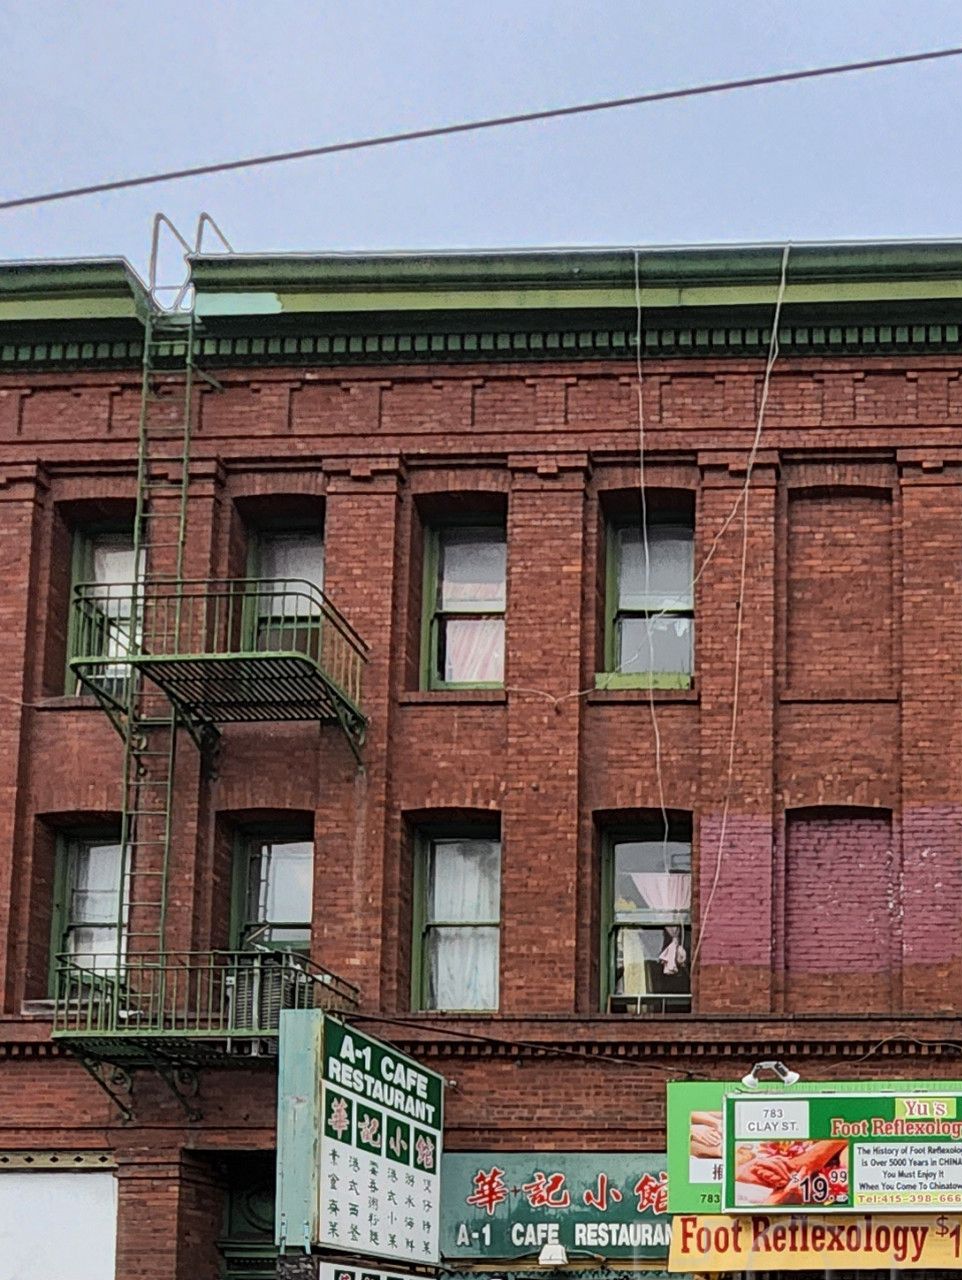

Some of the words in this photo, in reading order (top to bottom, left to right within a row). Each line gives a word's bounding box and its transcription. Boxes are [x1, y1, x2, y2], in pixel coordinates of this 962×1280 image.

[340, 1034, 372, 1071] A-1
[380, 1055, 428, 1100] CAFE
[328, 1056, 435, 1124] RESTAURANT
[763, 1109, 784, 1118] 783
[747, 1121, 780, 1132] CLAY
[781, 1121, 800, 1131] ST.
[831, 1118, 868, 1136] Foot
[857, 1147, 871, 1155] The
[873, 1146, 899, 1156] History
[901, 1146, 908, 1154] of
[910, 1146, 926, 1155] Foot
[870, 1159, 887, 1167] Over
[889, 1158, 907, 1167] 5000
[909, 1159, 929, 1167] Years
[883, 1170, 896, 1178] You
[898, 1170, 916, 1178] Must
[917, 1170, 937, 1180] Enjoy
[859, 1182, 879, 1190] When
[881, 1182, 894, 1190] You
[896, 1182, 917, 1190] Come
[919, 1182, 928, 1190] To
[456, 1223, 491, 1247] A-1
[511, 1223, 560, 1246] CAFE
[575, 1223, 672, 1247] RESTAURAN
[680, 1216, 742, 1254] Foot
[751, 1215, 928, 1262] Reflexology
